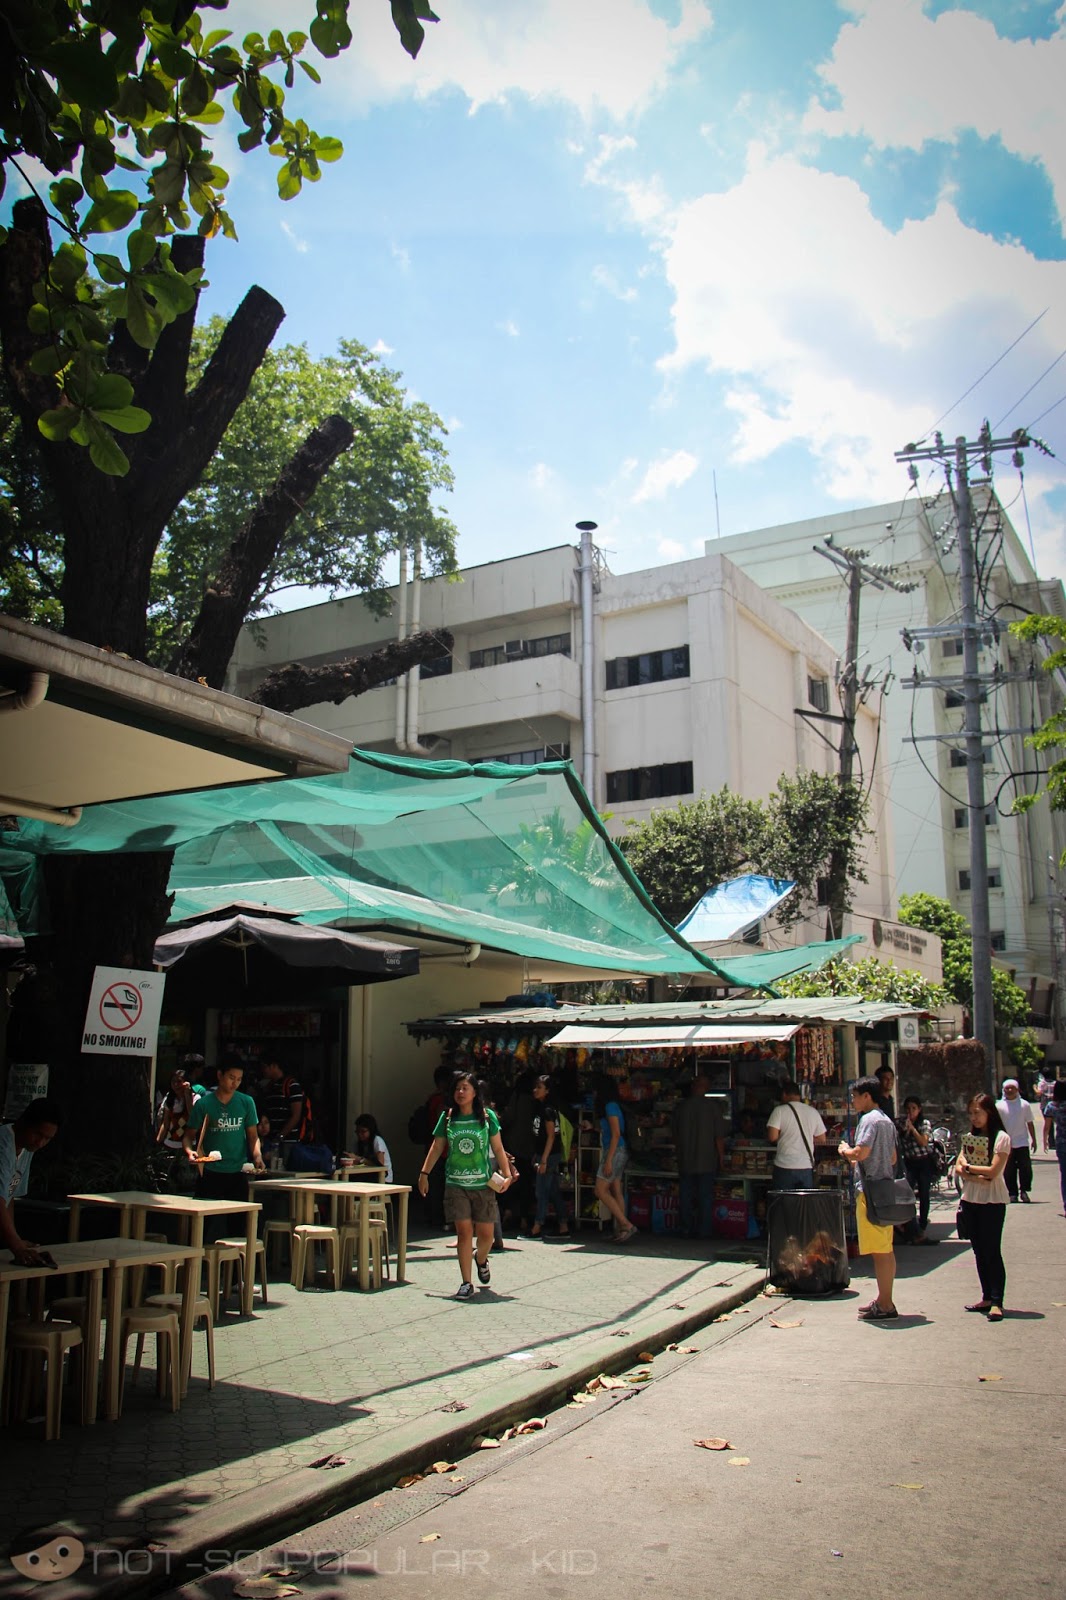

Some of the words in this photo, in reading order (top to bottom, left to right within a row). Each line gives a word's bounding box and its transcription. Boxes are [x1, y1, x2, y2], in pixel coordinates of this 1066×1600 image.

[83, 1033, 98, 1045] NO
[98, 1034, 147, 1049] SMOKING!
[217, 1117, 243, 1128] SALLE
